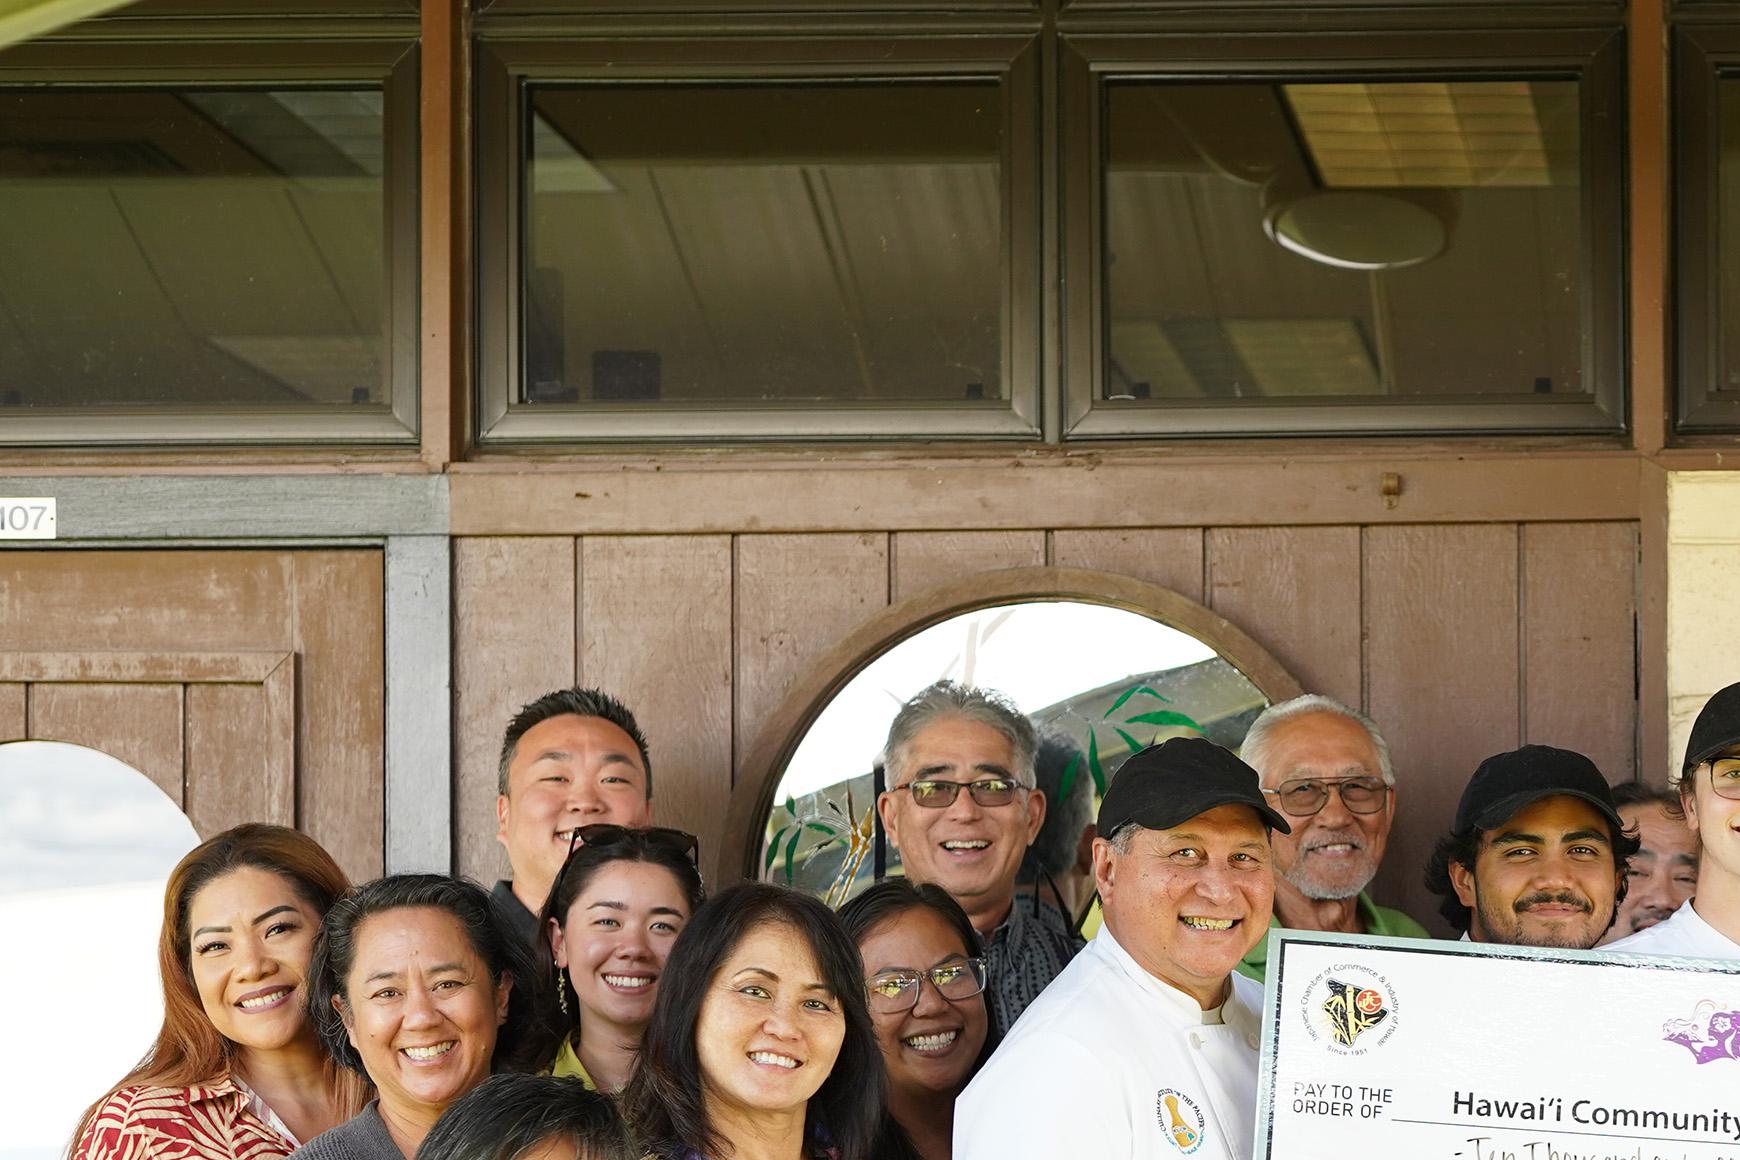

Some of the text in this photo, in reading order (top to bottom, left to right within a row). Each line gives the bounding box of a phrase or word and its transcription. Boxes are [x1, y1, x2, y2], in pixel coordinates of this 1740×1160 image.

[1334, 964, 1378, 978] Commerce
[1294, 1082, 1393, 1103] PAY TO THE
[1292, 1099, 1383, 1119] ORDER OF
